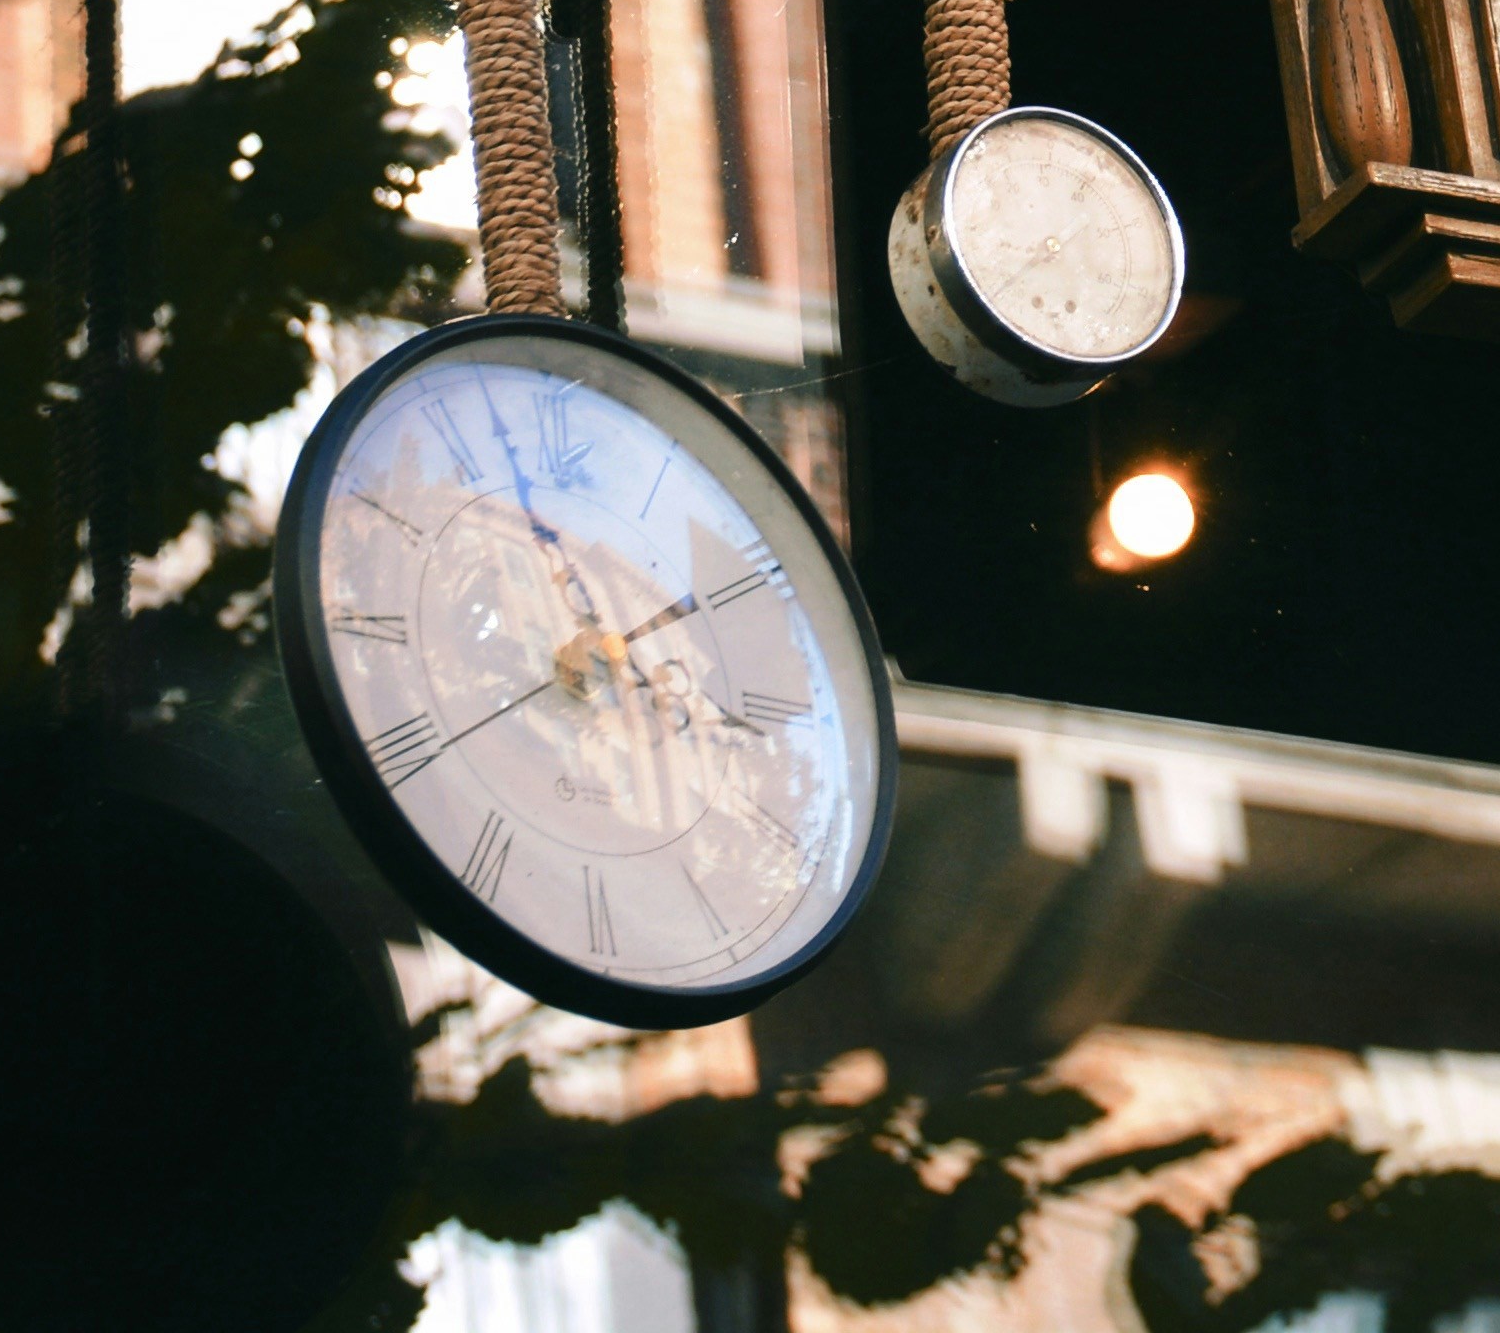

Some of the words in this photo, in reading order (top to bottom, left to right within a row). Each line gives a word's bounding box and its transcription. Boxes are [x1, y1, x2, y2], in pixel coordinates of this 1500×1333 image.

[706, 568, 770, 612] II
[742, 691, 816, 729] III
[362, 710, 445, 795] VIII
[459, 809, 516, 903] VII
